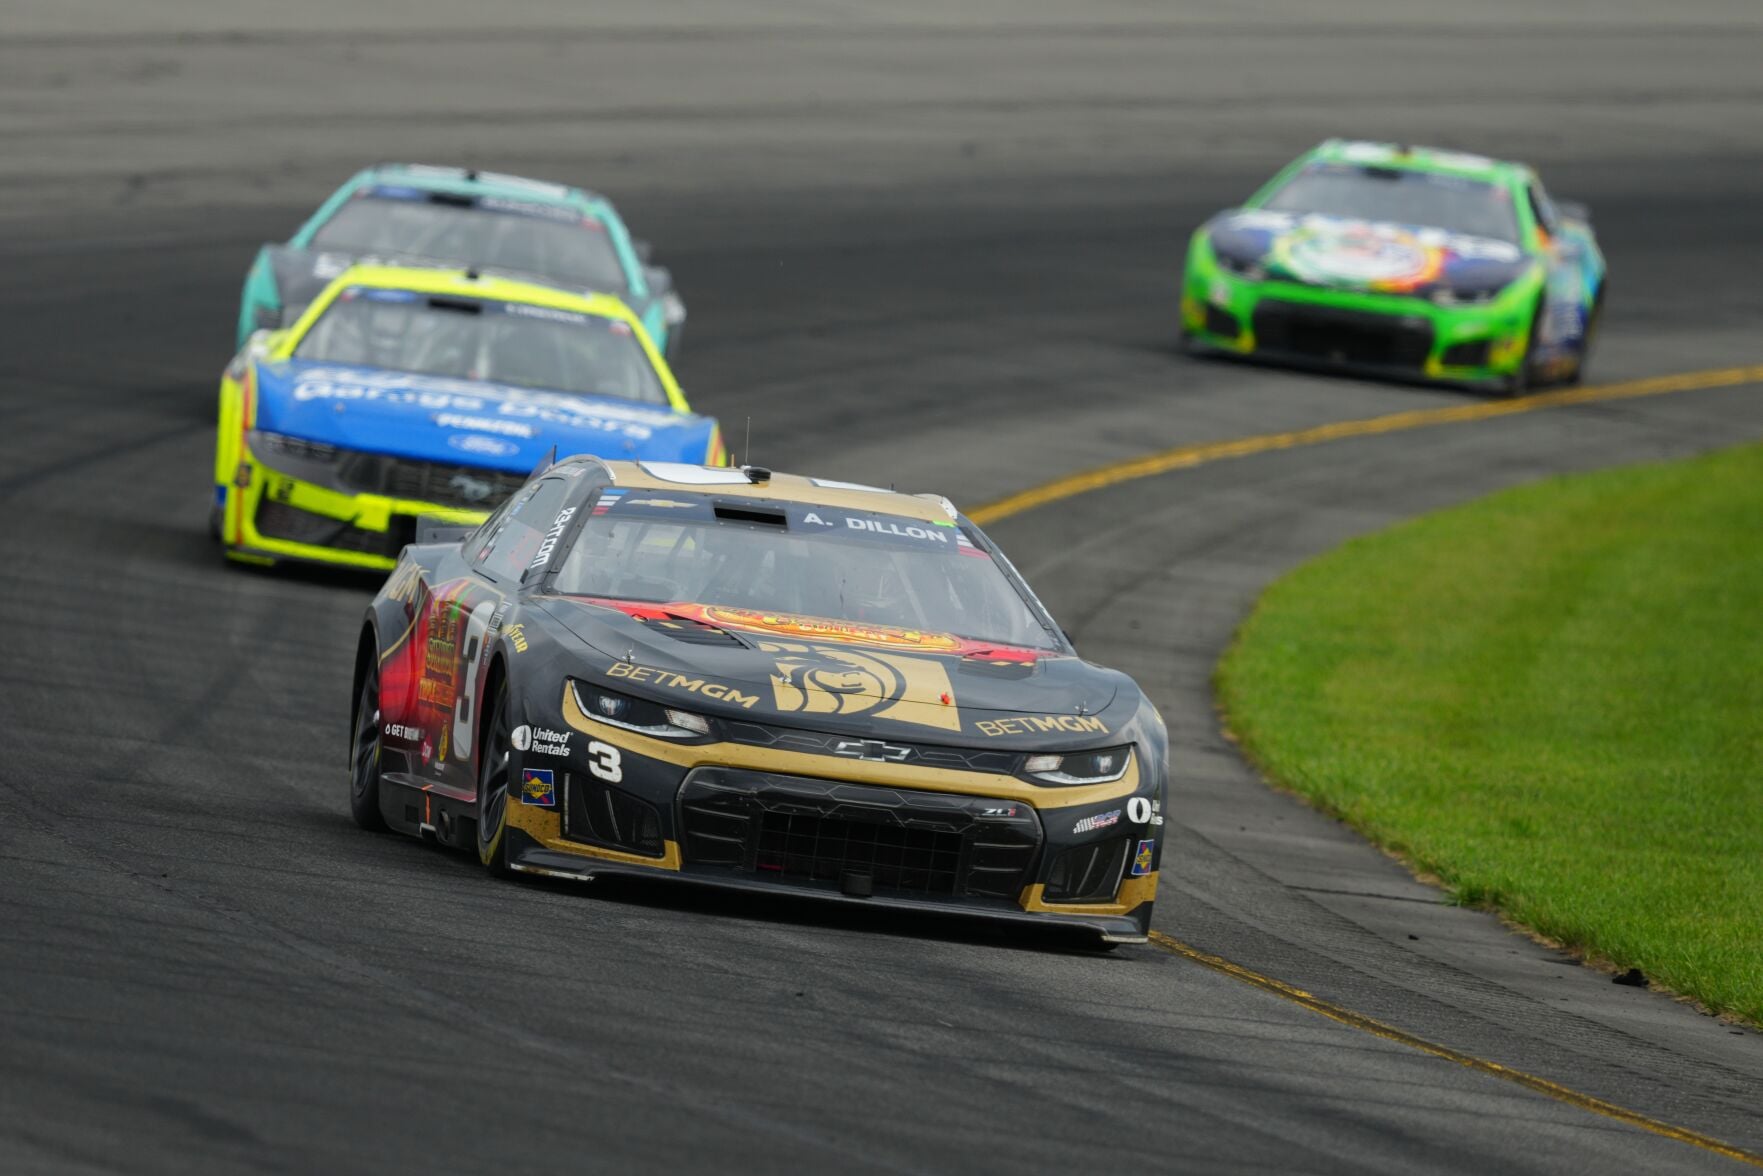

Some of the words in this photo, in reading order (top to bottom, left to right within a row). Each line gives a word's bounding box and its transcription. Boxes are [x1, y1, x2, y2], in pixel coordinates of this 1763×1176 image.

[804, 512, 833, 527] A.
[845, 517, 948, 543] DILLON
[453, 601, 497, 761] 3
[605, 661, 761, 709] BETMGM
[532, 727, 570, 743] United
[975, 715, 1110, 737] BETMGM
[531, 740, 570, 757] Rentals
[587, 740, 623, 783] 3
[523, 783, 552, 794] SUNOCO
